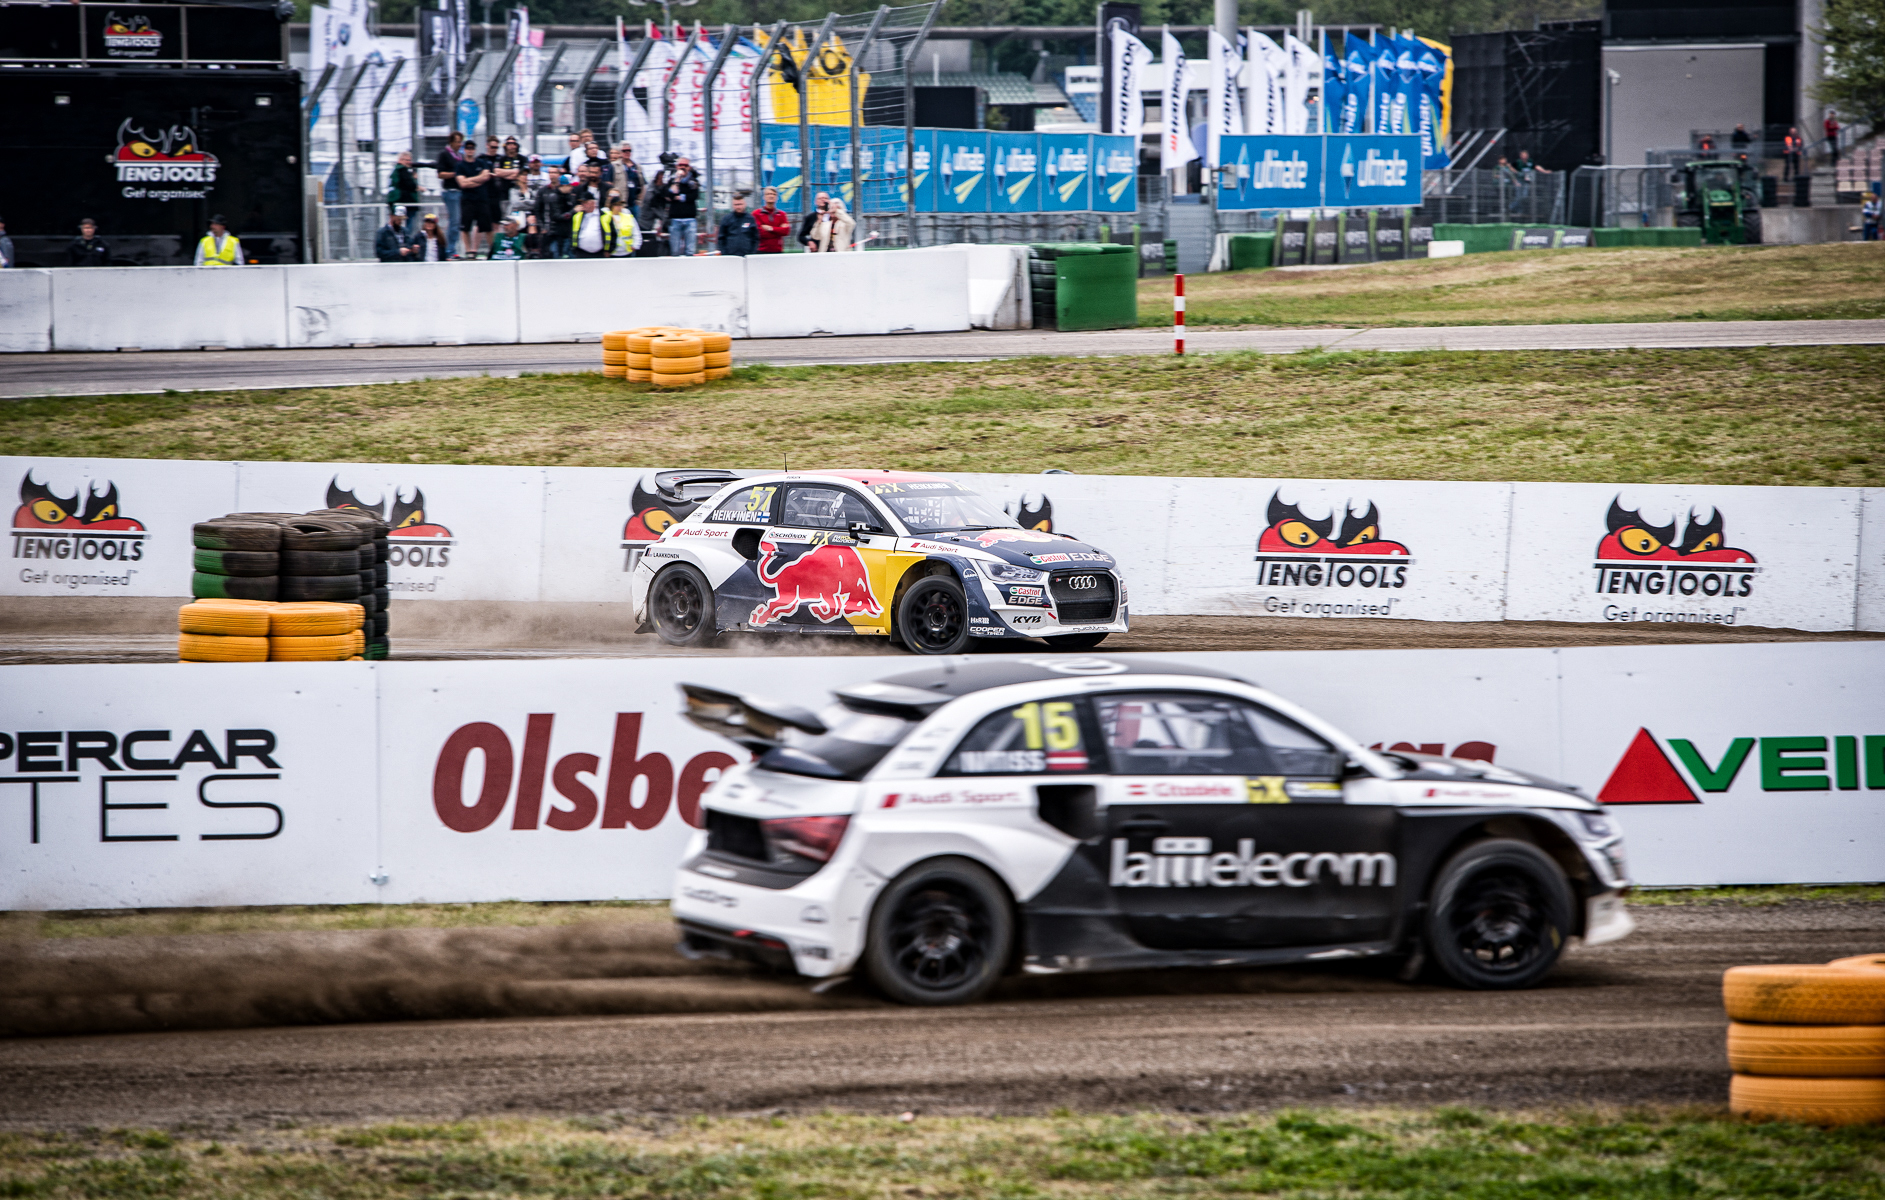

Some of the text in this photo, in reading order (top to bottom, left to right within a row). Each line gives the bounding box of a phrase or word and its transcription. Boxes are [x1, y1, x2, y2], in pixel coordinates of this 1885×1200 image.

[747, 486, 777, 511] 57
[711, 510, 758, 522] HEIKKINEN
[704, 529, 728, 538] Sport
[937, 545, 959, 553] Sport
[1040, 553, 1113, 563] Castrol EDGE
[19, 568, 49, 583] Get
[1018, 588, 1041, 596] Castrol
[1008, 595, 1043, 605] EDGE
[1264, 596, 1298, 613] Get
[1603, 604, 1637, 622] Get
[1013, 615, 1041, 624] KYB
[1012, 702, 1080, 750] 15
[432, 712, 739, 834] Olsbe
